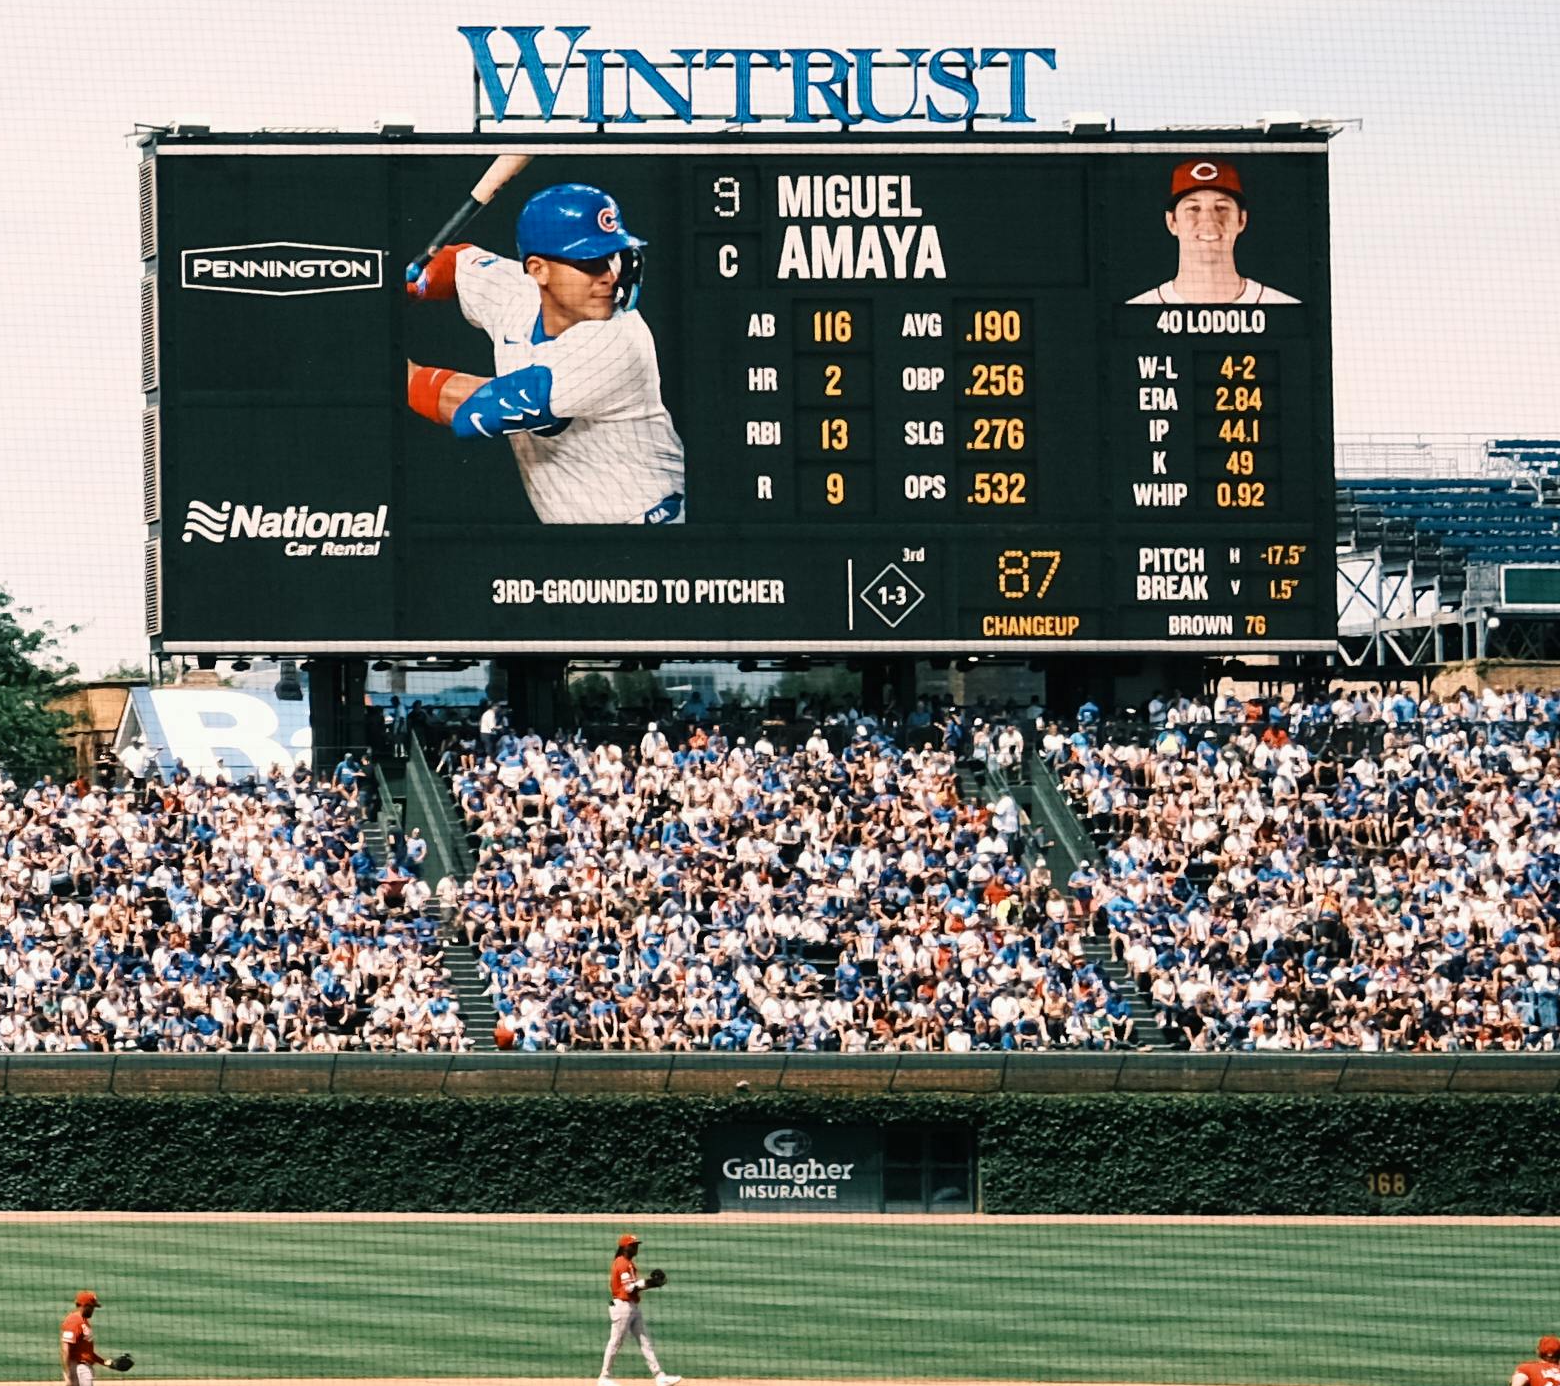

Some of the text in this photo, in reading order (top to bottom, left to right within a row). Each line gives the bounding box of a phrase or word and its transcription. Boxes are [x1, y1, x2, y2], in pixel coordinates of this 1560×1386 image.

[459, 26, 1056, 124] WINTRUST
[714, 177, 740, 217] 9
[778, 175, 922, 218] MIGUEL
[720, 245, 738, 277] C
[777, 225, 946, 279] AMAYA
[193, 259, 371, 278] PENNINGTON
[748, 311, 1020, 342] AB 116 AVG .190
[1156, 310, 1266, 333] 40 LODOLO
[748, 365, 1024, 395] HR 2 OBP .256
[1138, 355, 1256, 380] W-L 4-2
[1139, 387, 1262, 411] ERA 2.84
[746, 419, 1024, 450] RBI 13 SLG .276
[1149, 419, 1259, 443] IP 44.1
[1152, 450, 1254, 475] K 49
[757, 473, 1025, 504] R 9 OPS .532
[1133, 483, 1264, 506] WHIP 0.92
[230, 505, 389, 538] National
[285, 541, 380, 556] Car Rental
[902, 547, 925, 563] 3rd
[1139, 547, 1205, 573] PITCH
[998, 550, 1061, 599] 87
[492, 579, 785, 604] 3RD-GROUNDED TO PITCHER
[877, 586, 907, 605] 1-3
[1136, 575, 1209, 601] BREAK
[982, 615, 1080, 636] CHANGEUP
[1168, 616, 1266, 635] BROWN 76
[722, 1158, 855, 1184] Gallagher
[739, 1185, 837, 1199] INSURANCE
